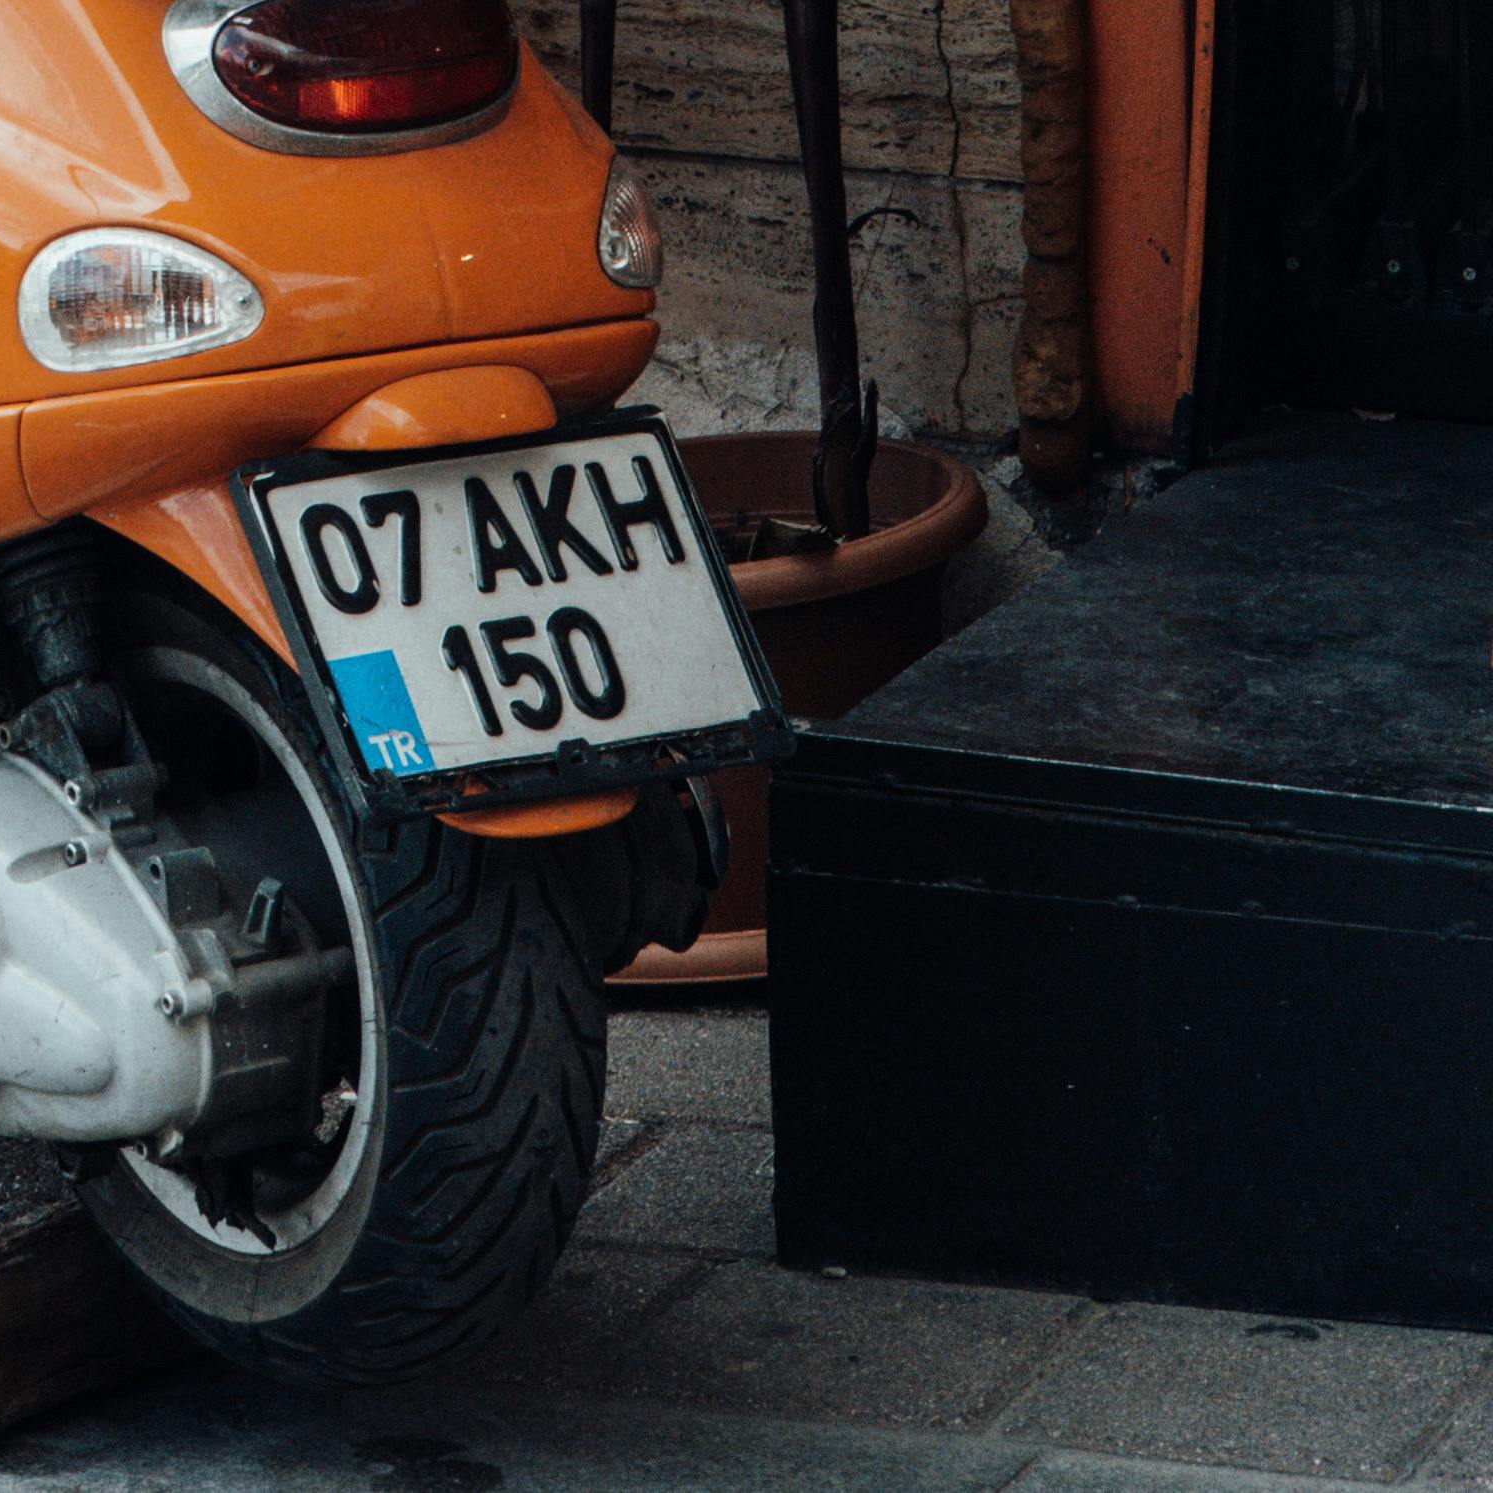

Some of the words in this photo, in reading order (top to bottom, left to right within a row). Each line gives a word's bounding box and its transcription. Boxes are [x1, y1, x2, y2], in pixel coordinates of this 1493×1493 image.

[297, 489, 420, 615] 07
[463, 455, 686, 595] AKH
[440, 605, 627, 737] 150
[368, 728, 423, 769] TR
